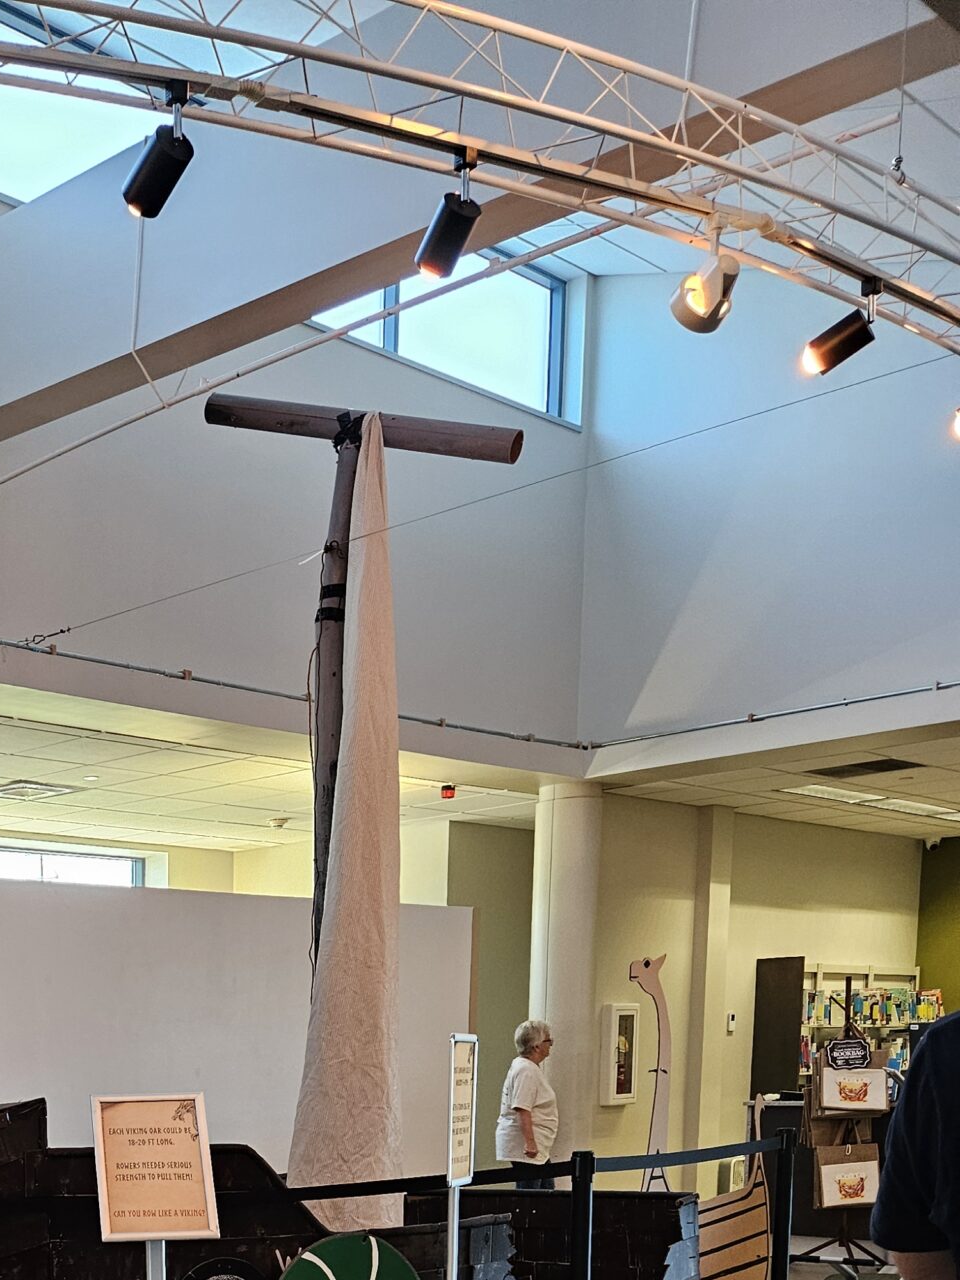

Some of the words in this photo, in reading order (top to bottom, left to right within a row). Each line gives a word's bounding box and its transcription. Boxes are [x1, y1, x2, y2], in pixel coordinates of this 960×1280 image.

[108, 1127, 125, 1136] EACH
[125, 1127, 148, 1135] VIKING
[148, 1127, 162, 1135] OAR
[147, 1138, 156, 1146] FT
[116, 1161, 141, 1170] ROWERS
[142, 1161, 166, 1169] NEEDED
[166, 1161, 193, 1169] SERIOUS
[115, 1173, 147, 1182] STRENGTH
[156, 1173, 173, 1181] PULL
[173, 1173, 193, 1181] THEM!
[113, 1210, 127, 1218] CAN
[127, 1210, 142, 1218] YOU
[142, 1209, 158, 1218] ROW
[158, 1209, 173, 1217] LIKE
[174, 1209, 180, 1217] A
[180, 1209, 206, 1217] VIKING?
